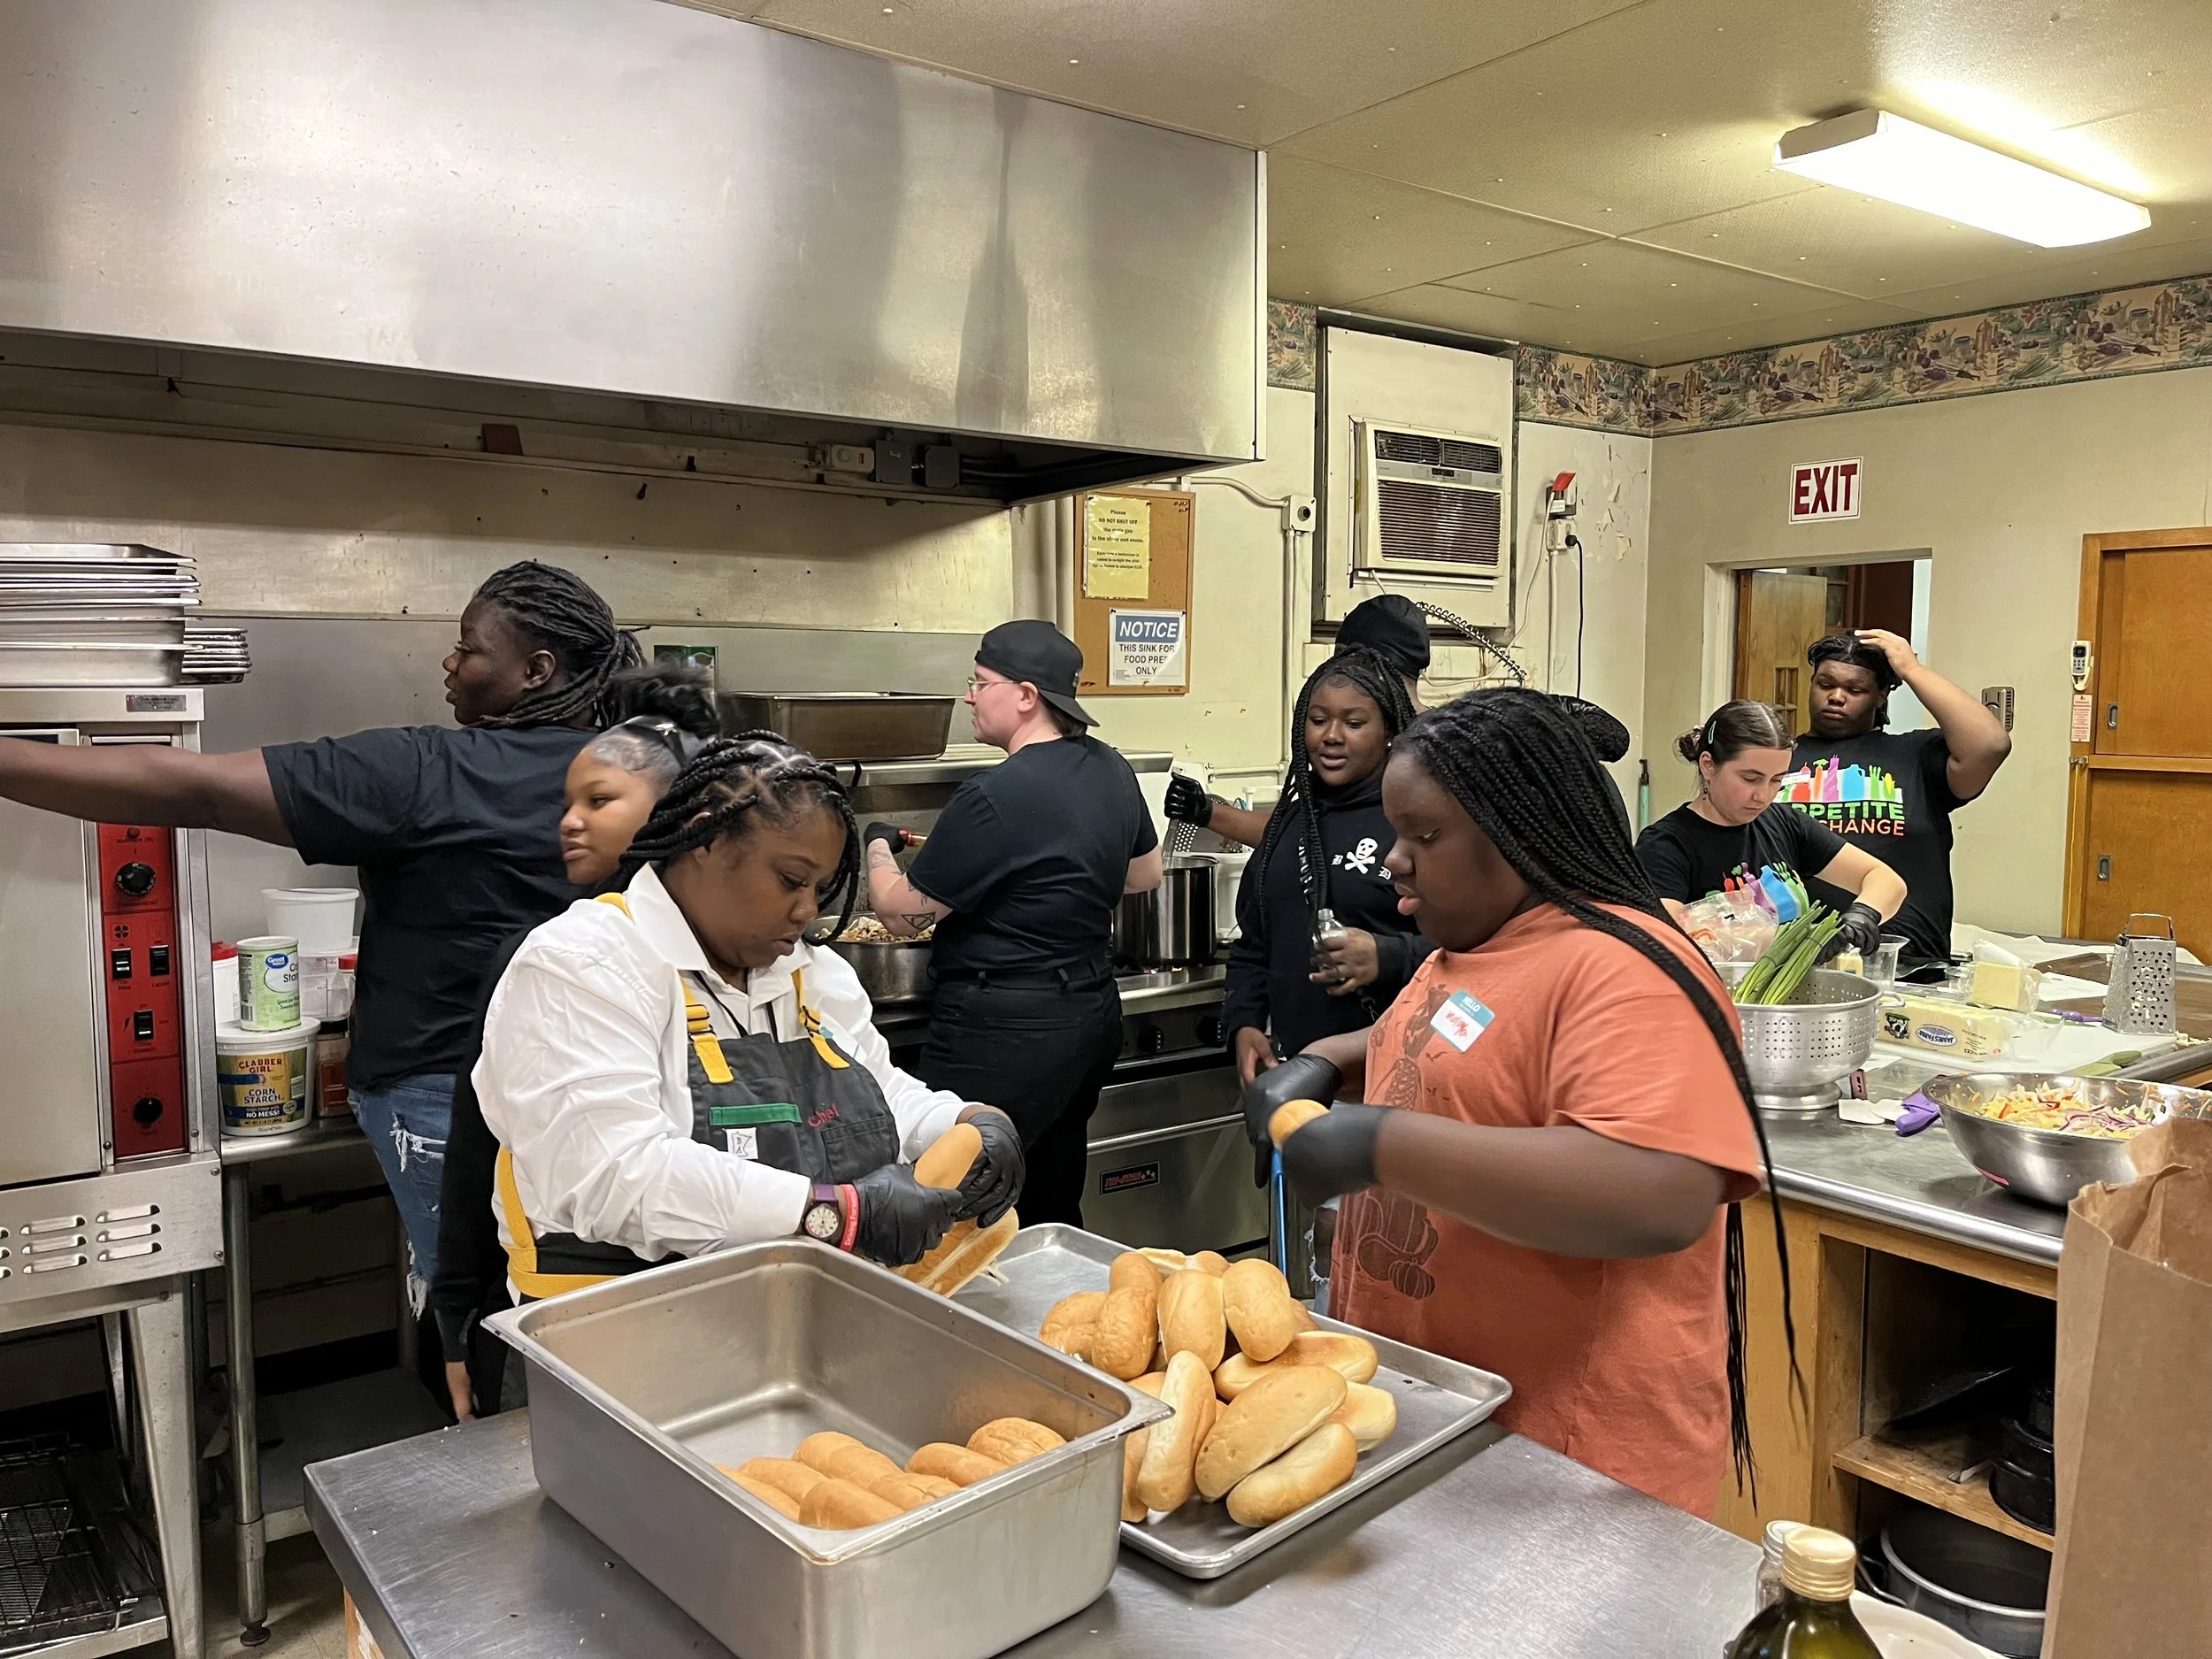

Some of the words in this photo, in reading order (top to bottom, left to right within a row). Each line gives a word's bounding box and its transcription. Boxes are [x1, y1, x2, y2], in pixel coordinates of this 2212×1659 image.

[1793, 463, 1858, 515] EXIT
[1119, 621, 1179, 637] NOTICE
[1792, 801, 1905, 819] PPETITE
[1935, 1035, 1954, 1044] JAMES
[238, 1058, 282, 1069] CLABBER
[244, 1094, 280, 1103] STARCH
[807, 1102, 840, 1128] Chef
